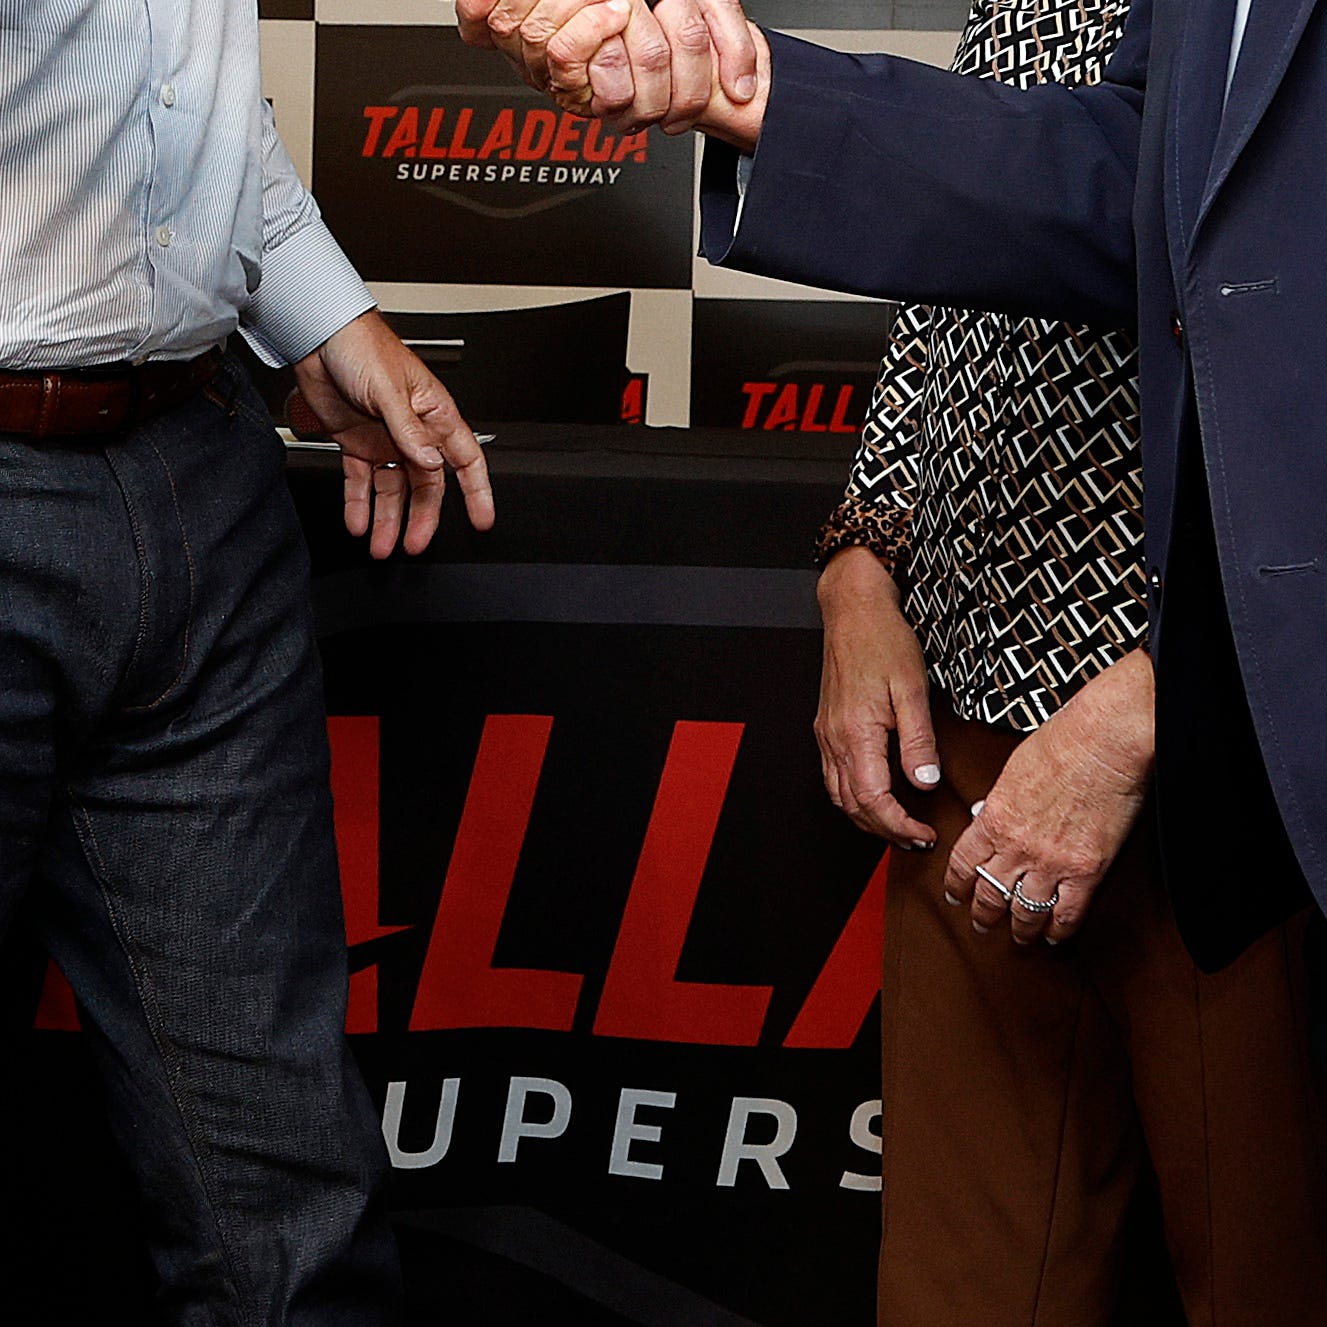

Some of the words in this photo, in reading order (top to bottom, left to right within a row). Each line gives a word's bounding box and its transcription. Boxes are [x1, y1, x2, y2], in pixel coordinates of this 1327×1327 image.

[361, 106, 649, 163] TALLADEGA
[396, 163, 622, 185] SUPERSPEEDWAY
[741, 382, 864, 433] TALL
